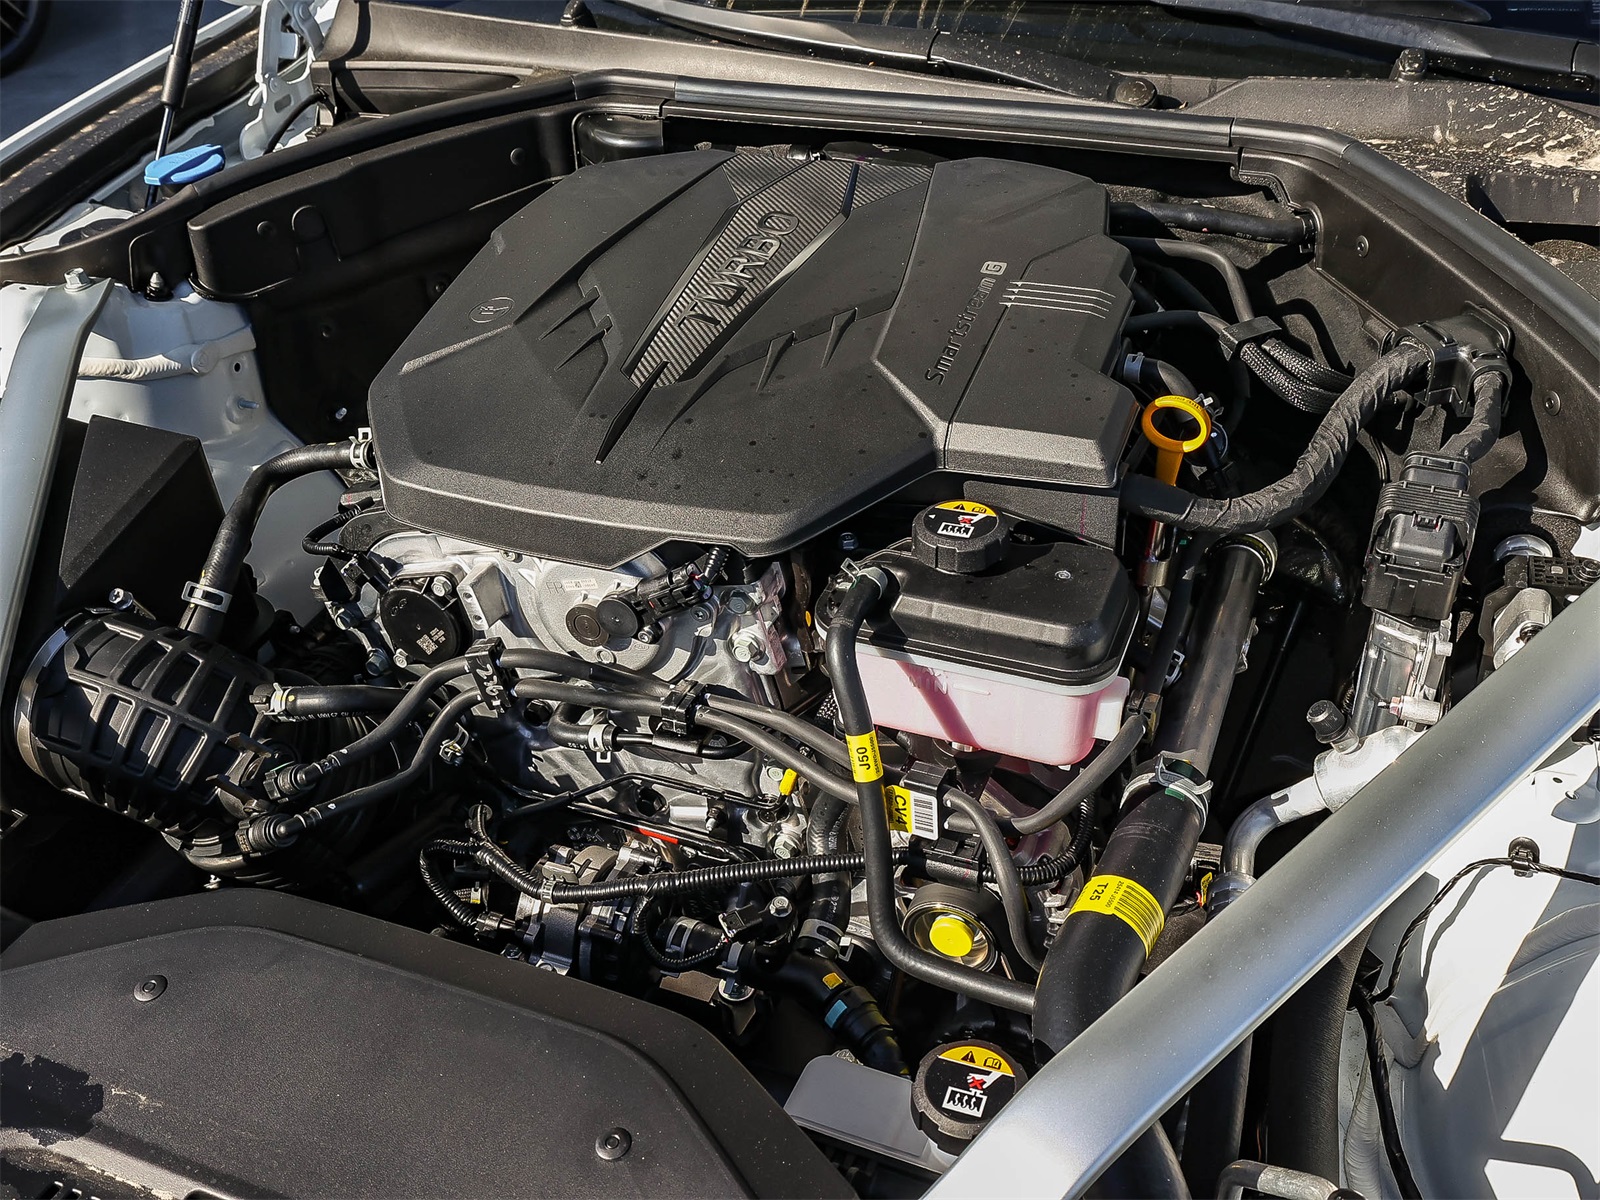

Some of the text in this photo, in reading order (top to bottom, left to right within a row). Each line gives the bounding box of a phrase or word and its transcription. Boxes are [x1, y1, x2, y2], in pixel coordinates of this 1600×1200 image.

[673, 210, 800, 328] TURBO
[924, 261, 1005, 386] Smartstream G
[856, 746, 871, 771] J50
[894, 794, 908, 825] CV4
[1089, 882, 1109, 901] T25
